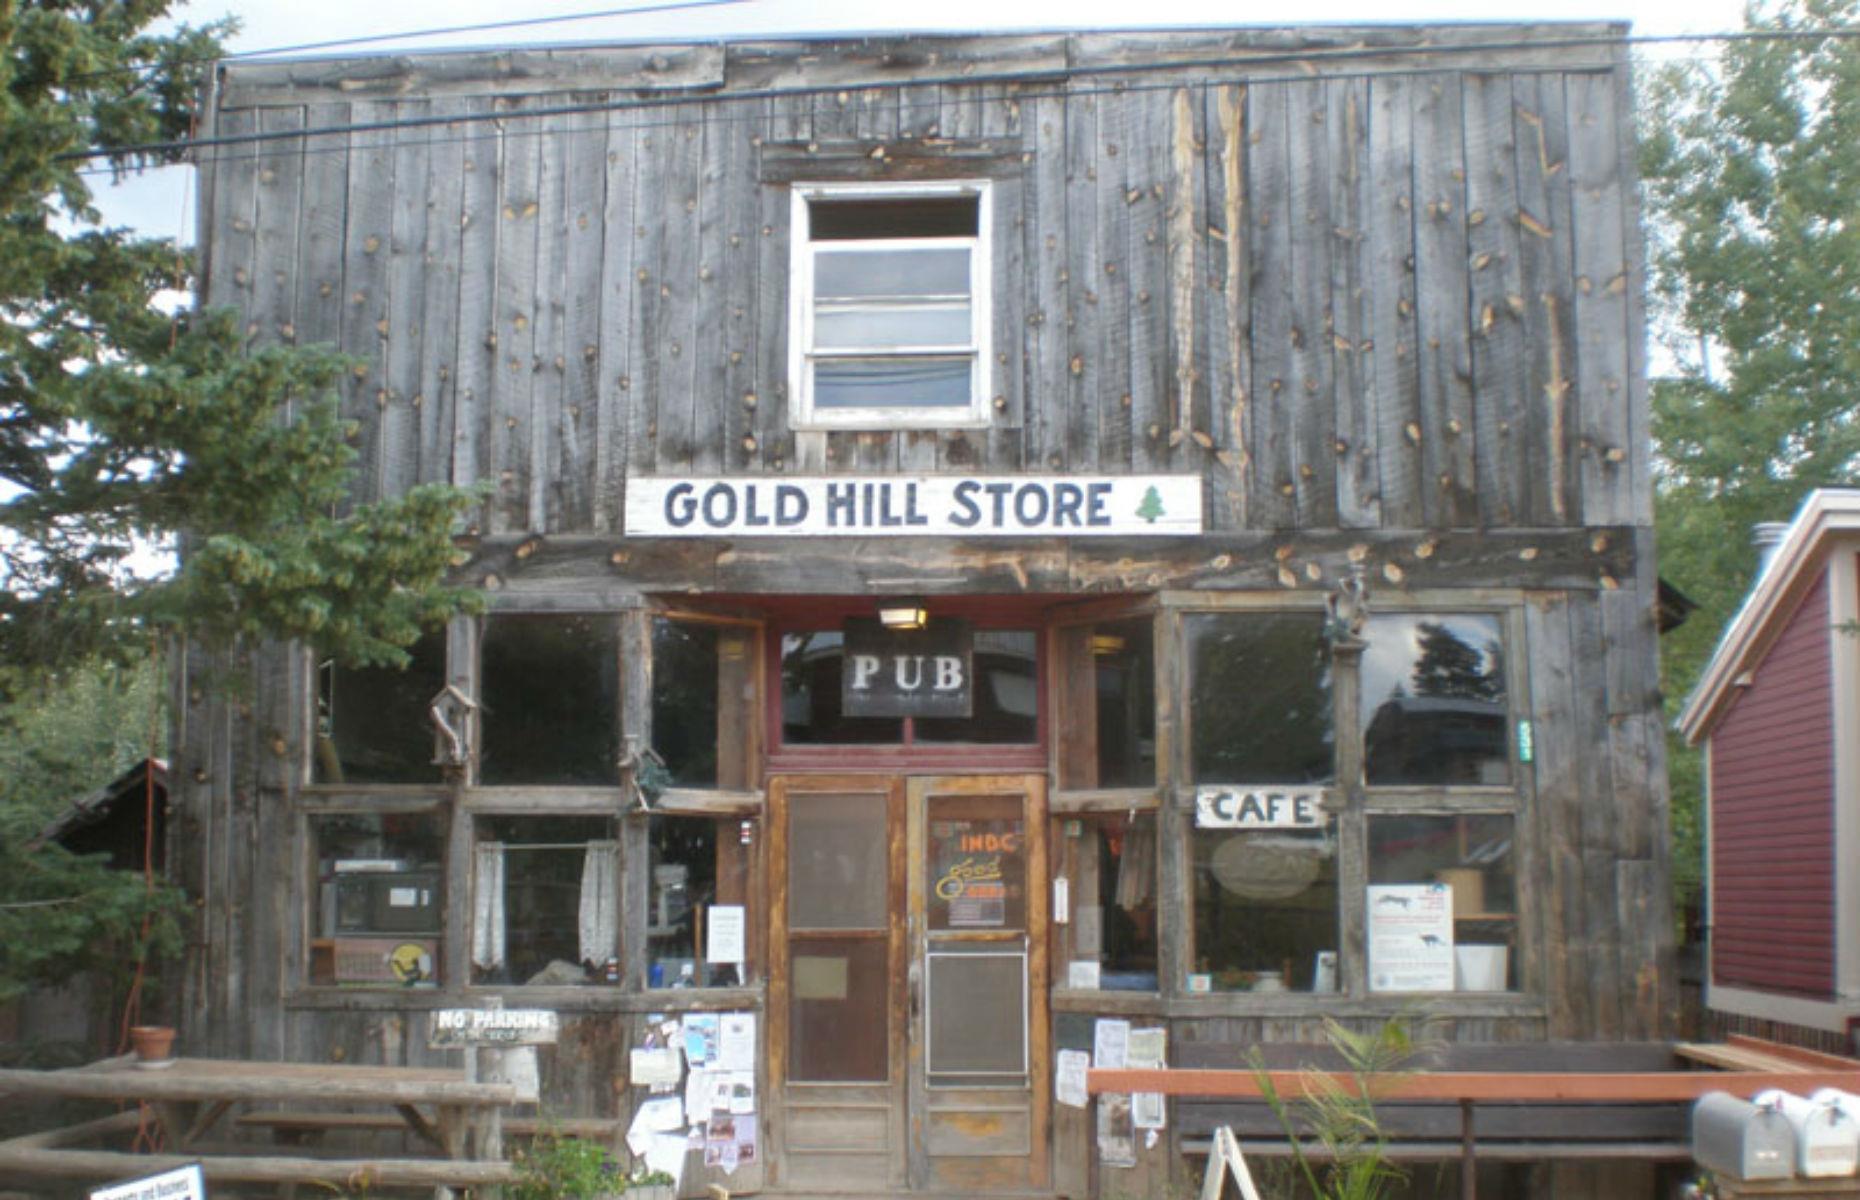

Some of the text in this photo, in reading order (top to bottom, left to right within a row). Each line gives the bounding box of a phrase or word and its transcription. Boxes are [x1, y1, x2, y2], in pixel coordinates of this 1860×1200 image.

[664, 480, 1113, 528] GOLD HILL STORE
[852, 655, 964, 690] PUB
[1211, 793, 1315, 824] CAFE
[438, 1010, 551, 1029] NO PARKING
